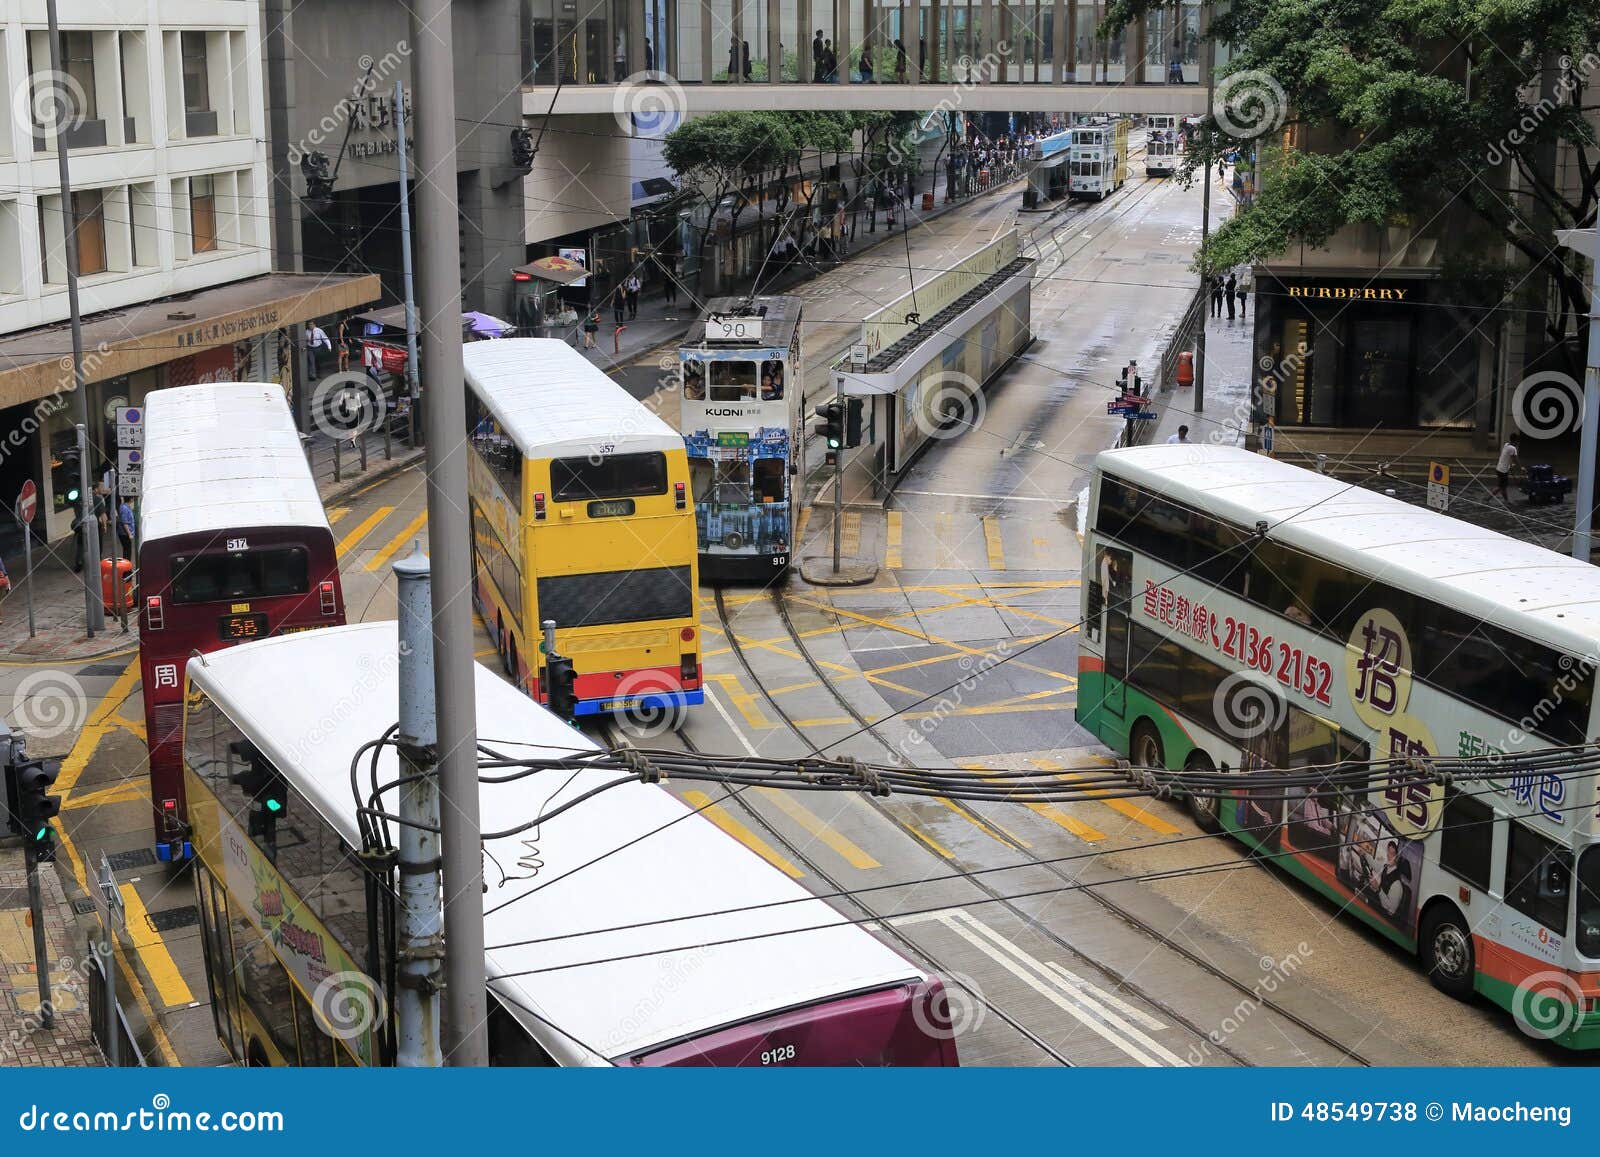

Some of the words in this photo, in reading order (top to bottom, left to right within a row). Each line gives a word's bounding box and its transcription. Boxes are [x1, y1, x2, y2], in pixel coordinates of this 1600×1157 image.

[1288, 287, 1408, 299] BURBERRY
[722, 323, 745, 337] 90
[705, 408, 743, 417] KUONI
[600, 445, 615, 453] 357
[228, 538, 247, 550] 517
[773, 557, 785, 565] 90
[1143, 579, 1208, 643] 登記熱線
[1222, 616, 1274, 676] 2136
[1276, 642, 1333, 707] 2152
[155, 664, 179, 689] 周
[761, 1045, 795, 1065] 9128
